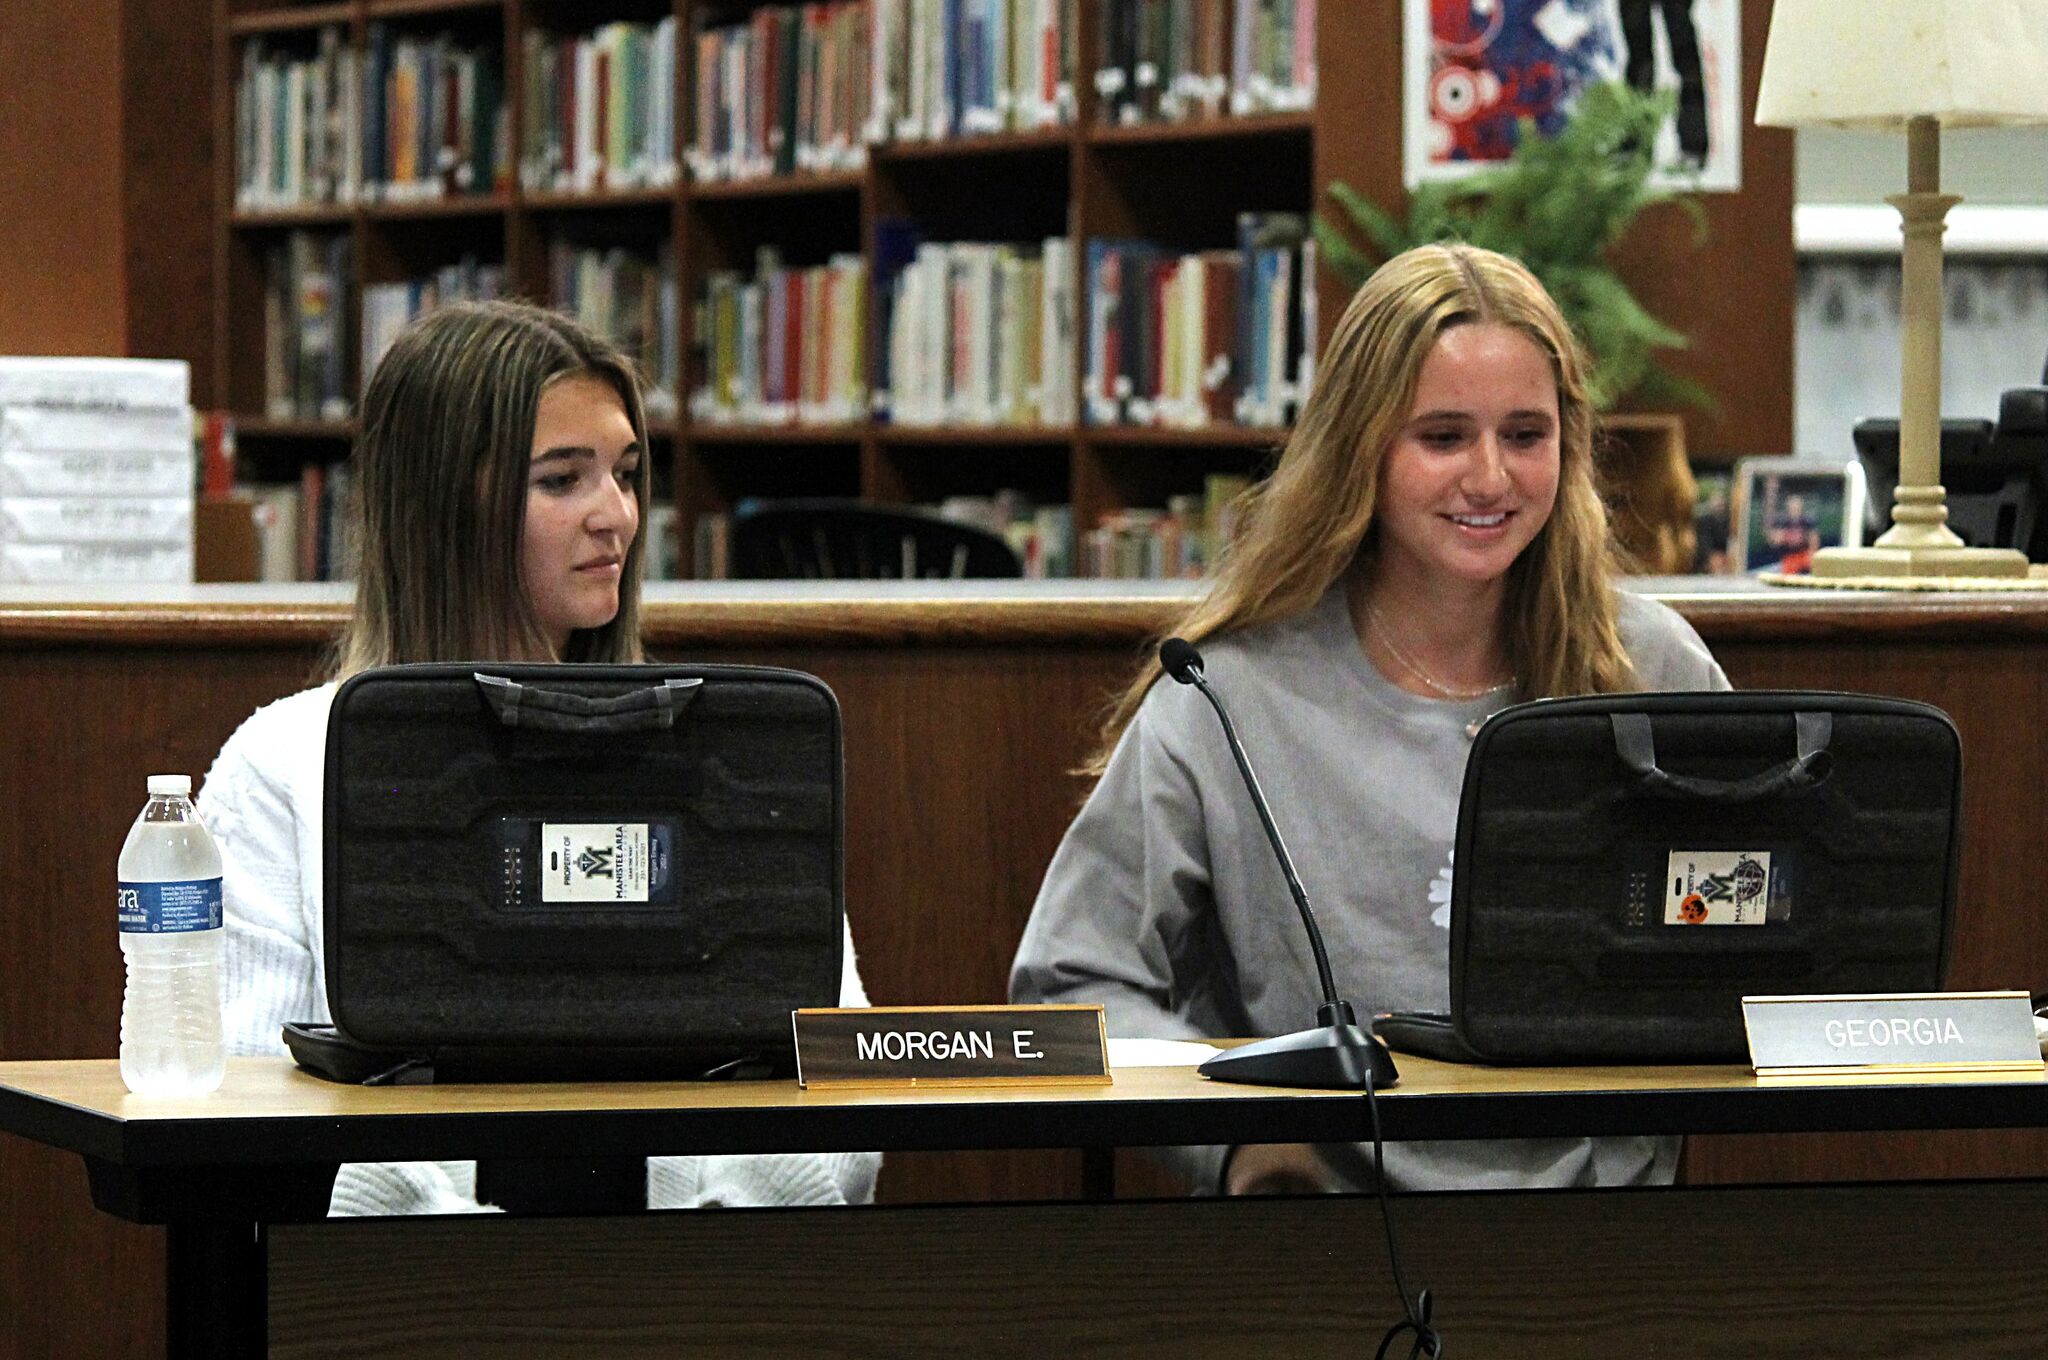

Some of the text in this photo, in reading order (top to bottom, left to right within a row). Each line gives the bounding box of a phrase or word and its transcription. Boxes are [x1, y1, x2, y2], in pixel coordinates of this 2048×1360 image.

[563, 835, 571, 886] PROPERTY OF
[615, 825, 624, 898] MANISTEE AREA
[118, 889, 139, 909] ara
[857, 1030, 1044, 1061] MORGAN E.
[1825, 1017, 1964, 1048] GEORGIA
